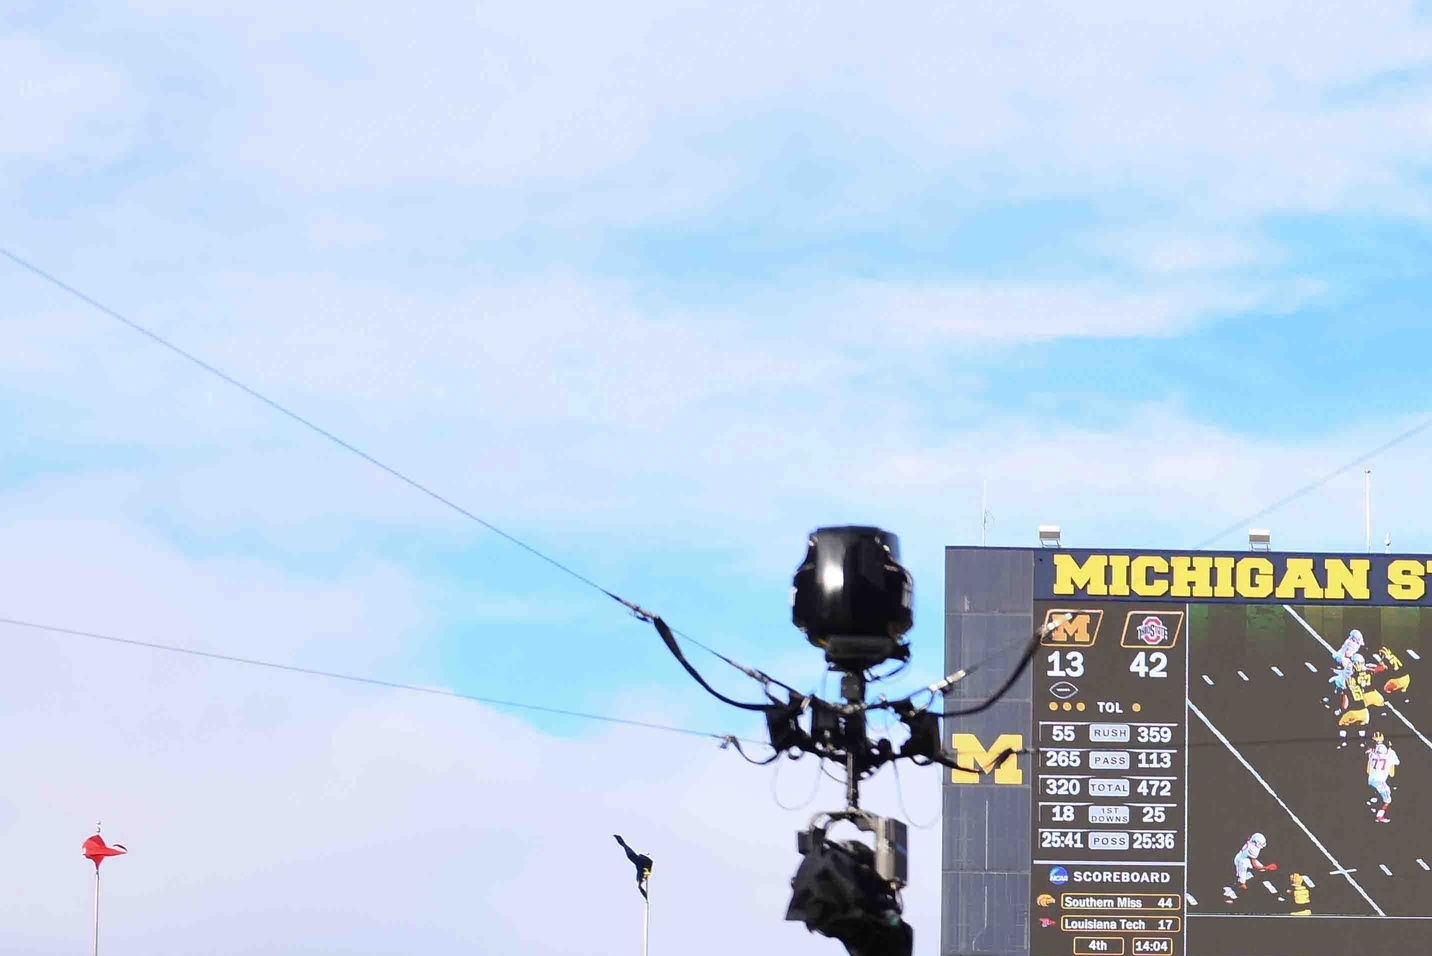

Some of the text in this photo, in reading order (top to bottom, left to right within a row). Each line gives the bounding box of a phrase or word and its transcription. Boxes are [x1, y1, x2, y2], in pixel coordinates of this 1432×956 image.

[1053, 554, 1370, 599] MICHIGAN
[1052, 614, 1090, 642] M
[1046, 651, 1085, 677] 13
[1129, 652, 1168, 678] 42
[1097, 702, 1123, 713] TOL
[1052, 726, 1172, 742] 55 RUSH 359
[952, 733, 1022, 784] M
[1046, 751, 1172, 768] 265 PASS 113
[1046, 779, 1172, 796] 320 TOTAL 472
[1052, 806, 1075, 821] 18
[1142, 807, 1166, 823] 25
[1041, 832, 1084, 848] 25:41
[1132, 833, 1175, 849] 25:36
[1073, 871, 1170, 883] SCOREBOARD
[1064, 896, 1173, 908] Southern Miss 44
[1064, 918, 1173, 930] Louisiana Tech 17
[1088, 940, 1107, 951] 4th
[1135, 941, 1168, 952] 14:04
